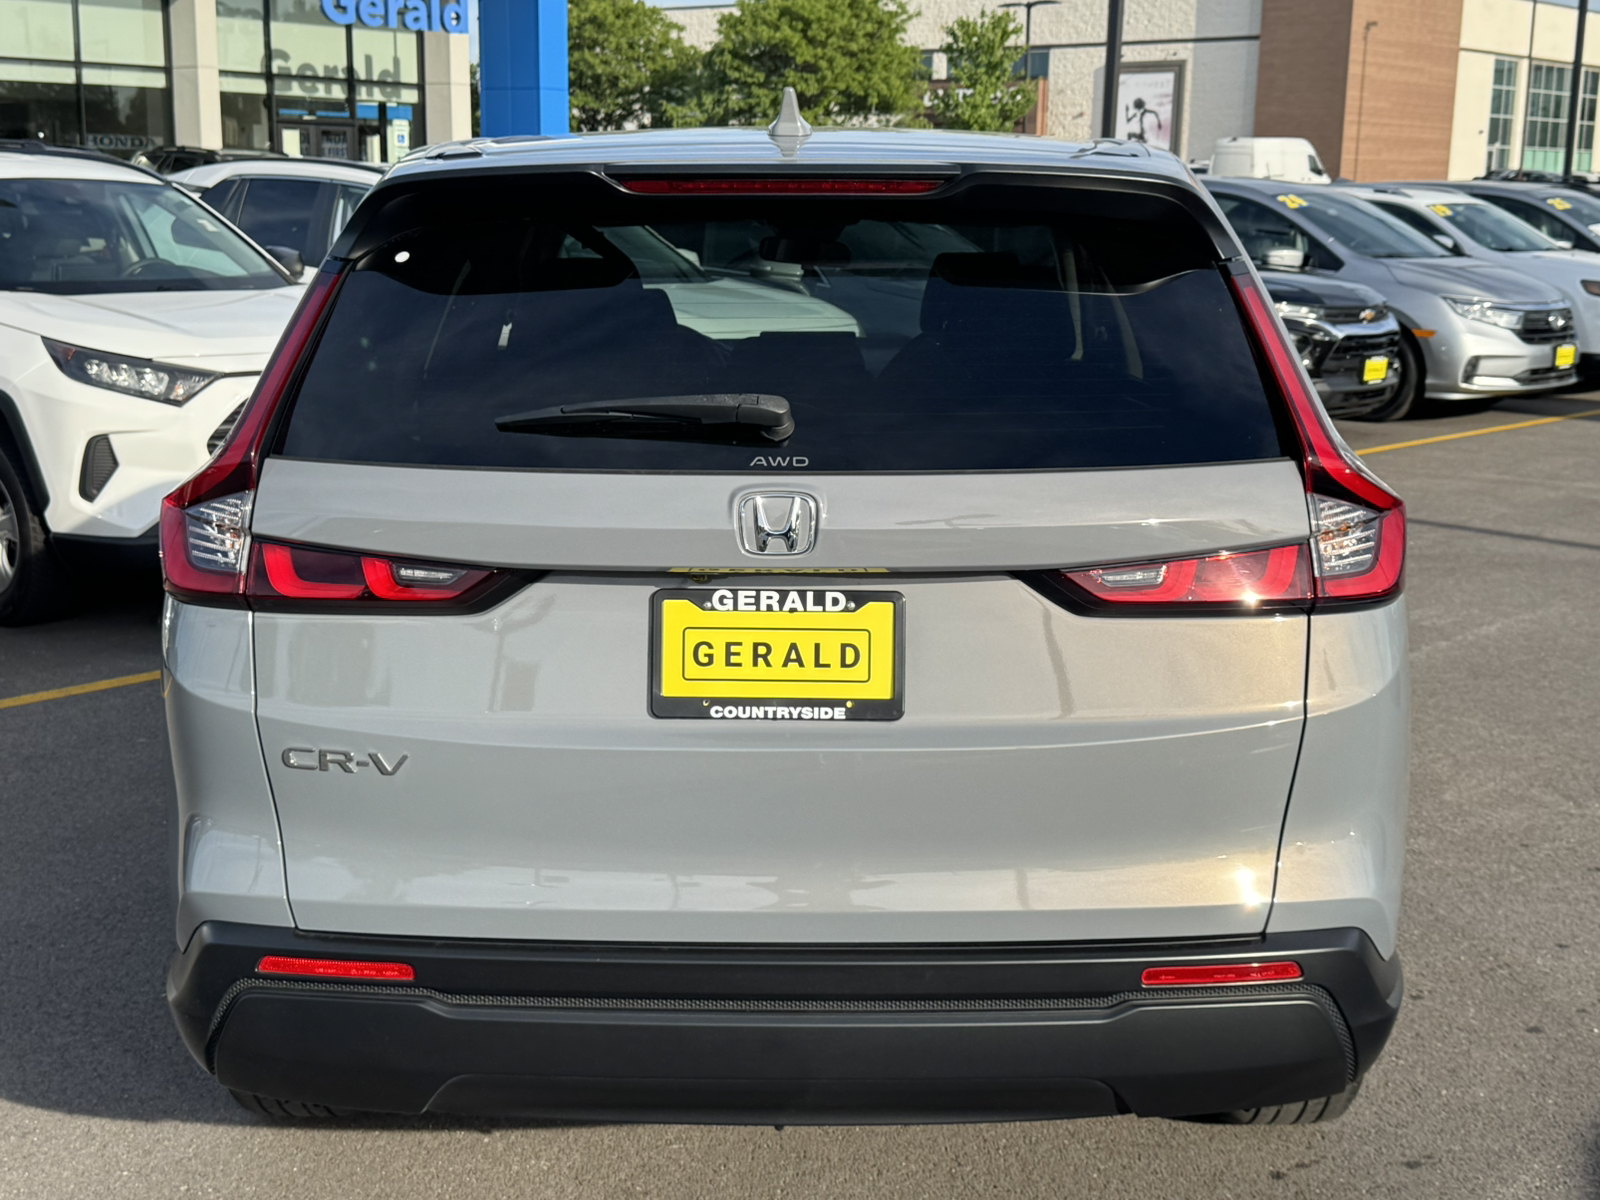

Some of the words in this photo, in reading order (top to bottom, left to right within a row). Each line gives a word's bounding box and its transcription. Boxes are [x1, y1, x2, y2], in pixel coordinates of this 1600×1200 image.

[320, 0, 470, 35] Gerald
[749, 455, 810, 468] AWD
[711, 589, 847, 612] GERALD
[692, 640, 861, 669] GERALD
[709, 706, 846, 720] COUNTRYSIDE
[281, 747, 410, 777] CR-V
